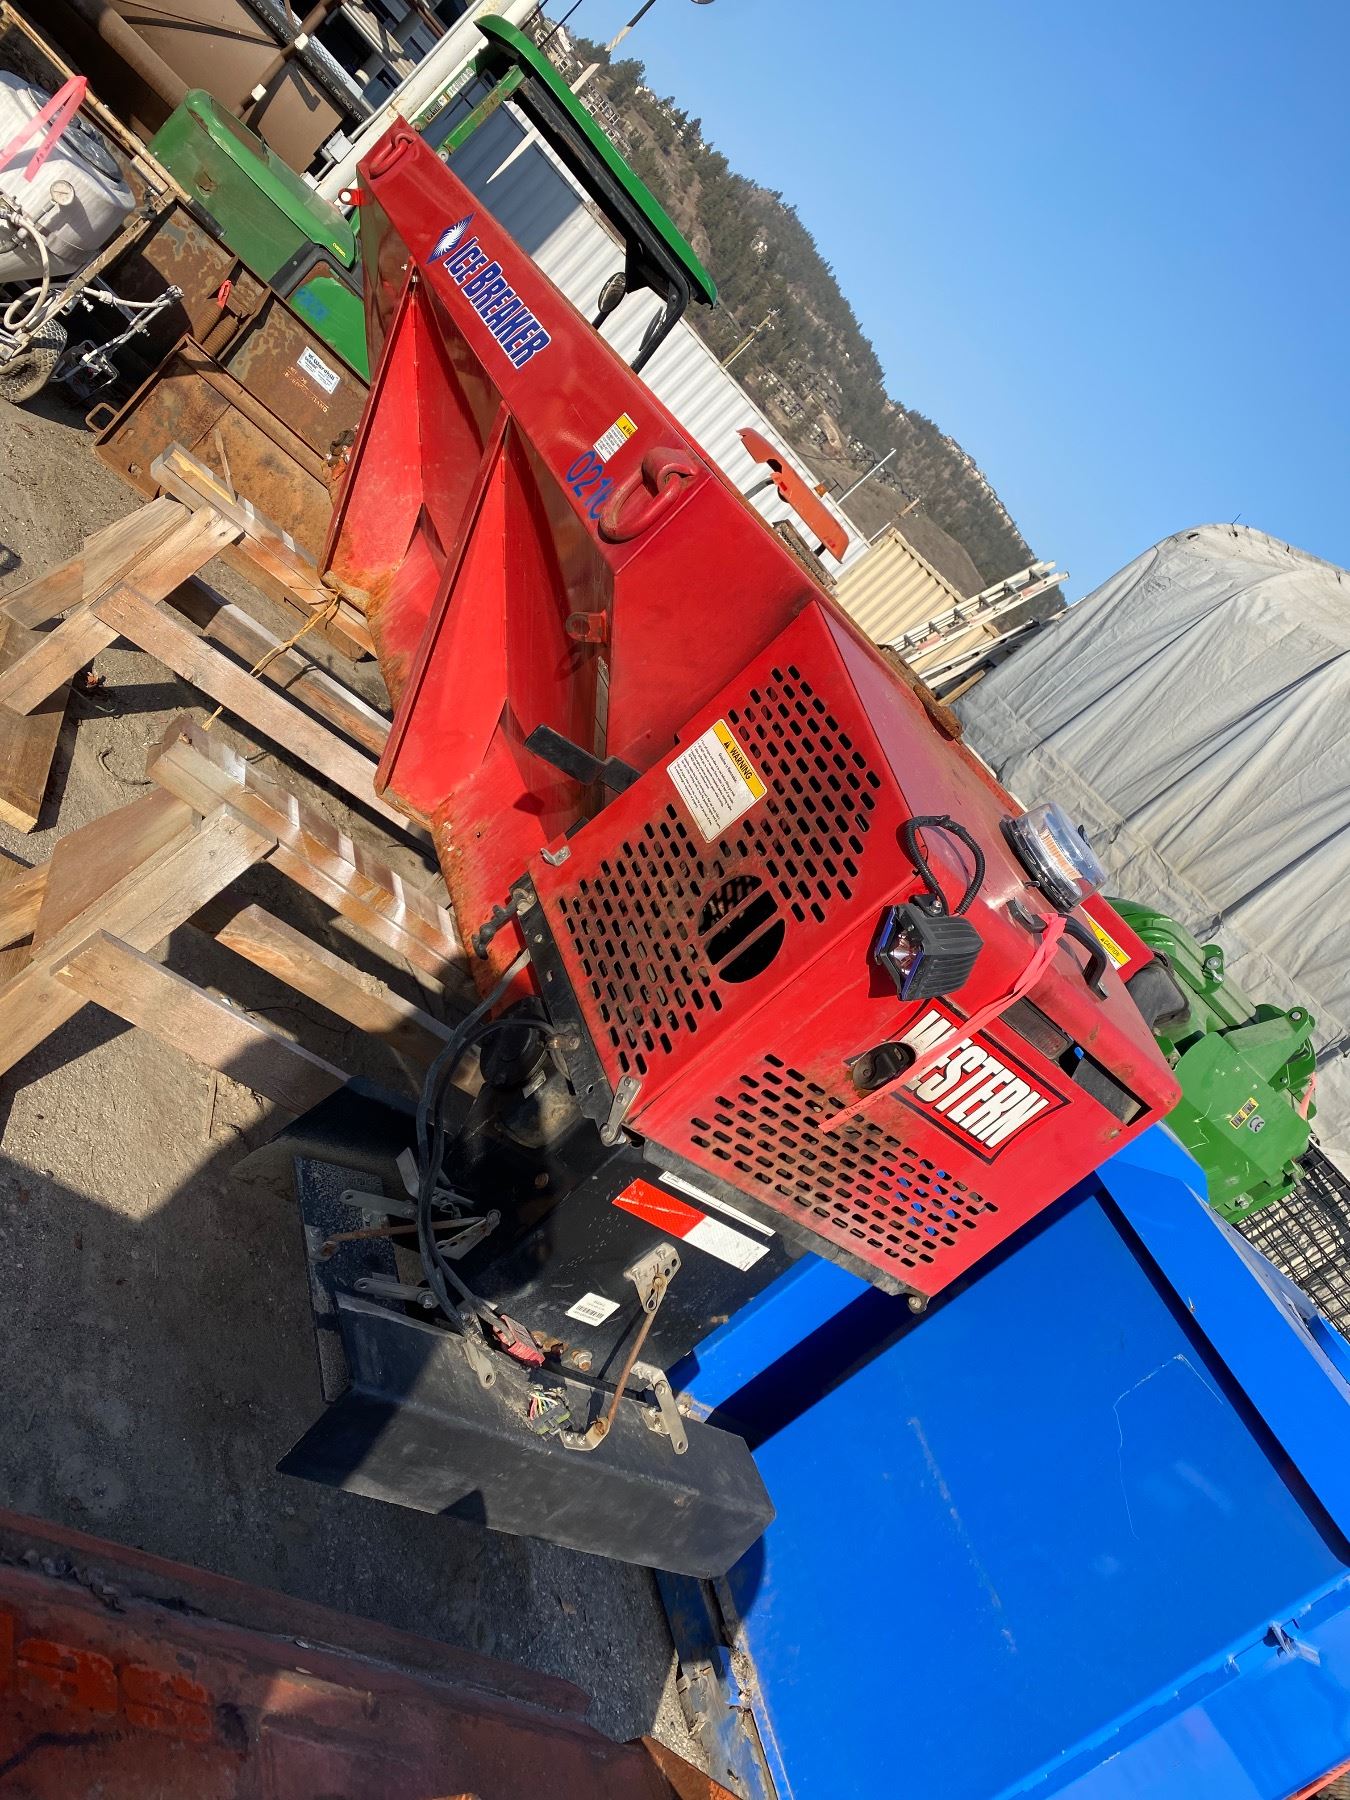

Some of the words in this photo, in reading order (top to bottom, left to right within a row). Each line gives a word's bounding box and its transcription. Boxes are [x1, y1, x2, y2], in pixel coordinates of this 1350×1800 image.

[441, 236, 489, 286] ICE
[460, 260, 551, 369] BREAKER
[729, 746, 753, 780] WARNING
[890, 1008, 1050, 1149] WESTERN
